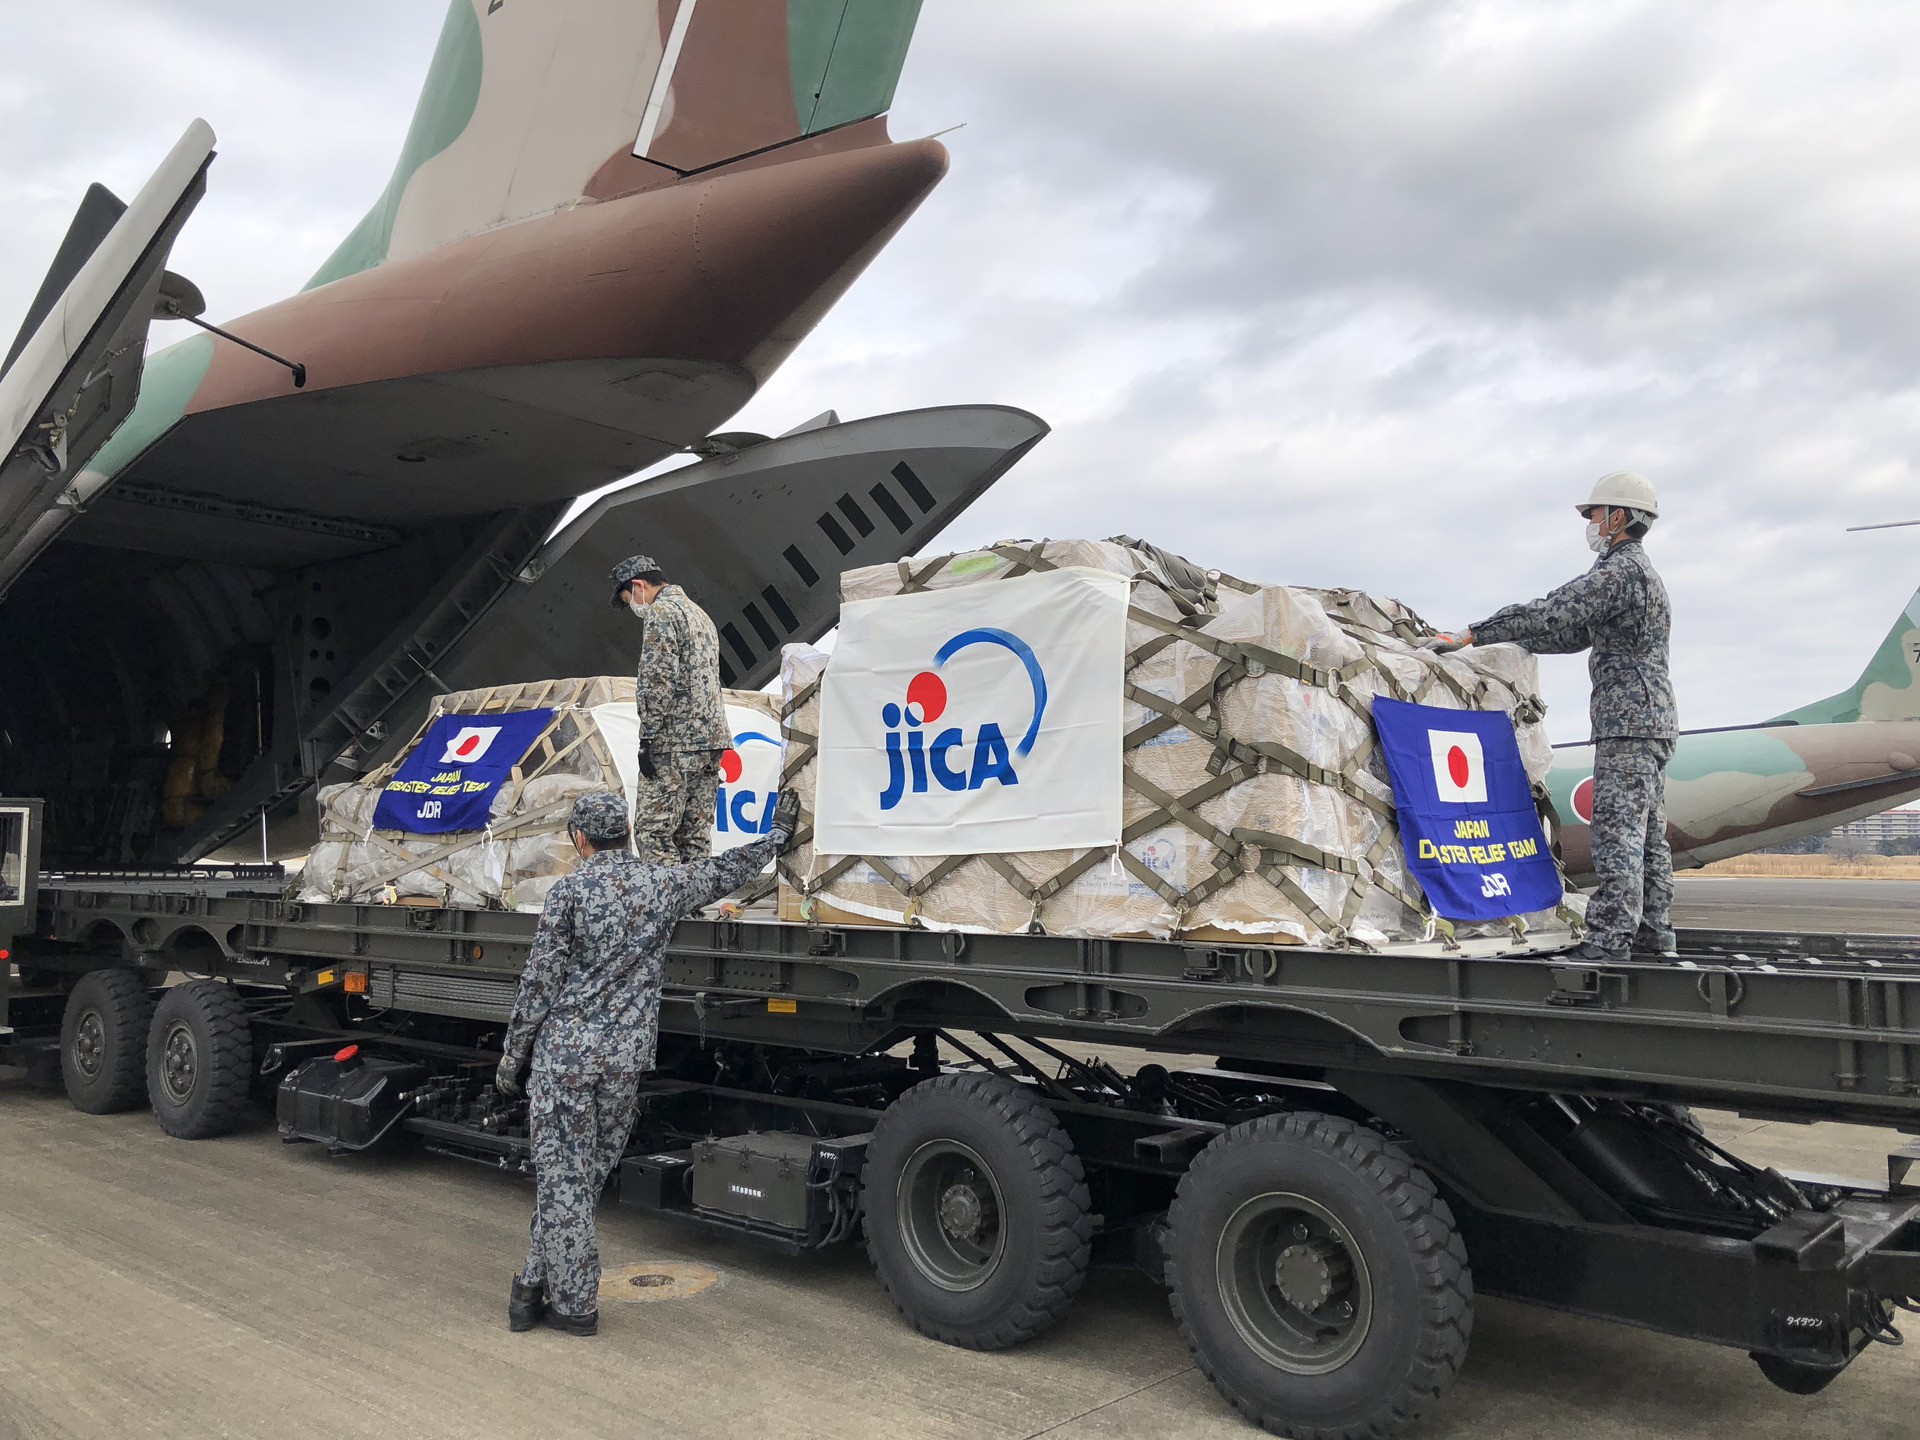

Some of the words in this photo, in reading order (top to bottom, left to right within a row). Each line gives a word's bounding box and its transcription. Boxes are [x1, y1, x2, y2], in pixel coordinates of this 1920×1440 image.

[431, 769, 462, 783] JAPAN
[385, 780, 432, 793] DISASTER
[428, 783, 463, 795] RELIEF
[417, 801, 442, 819] JDR
[1454, 820, 1490, 839] JAPAN
[1468, 844, 1507, 864] RELIEF
[1507, 838, 1538, 859] TEAM
[1481, 872, 1512, 898] JDR
